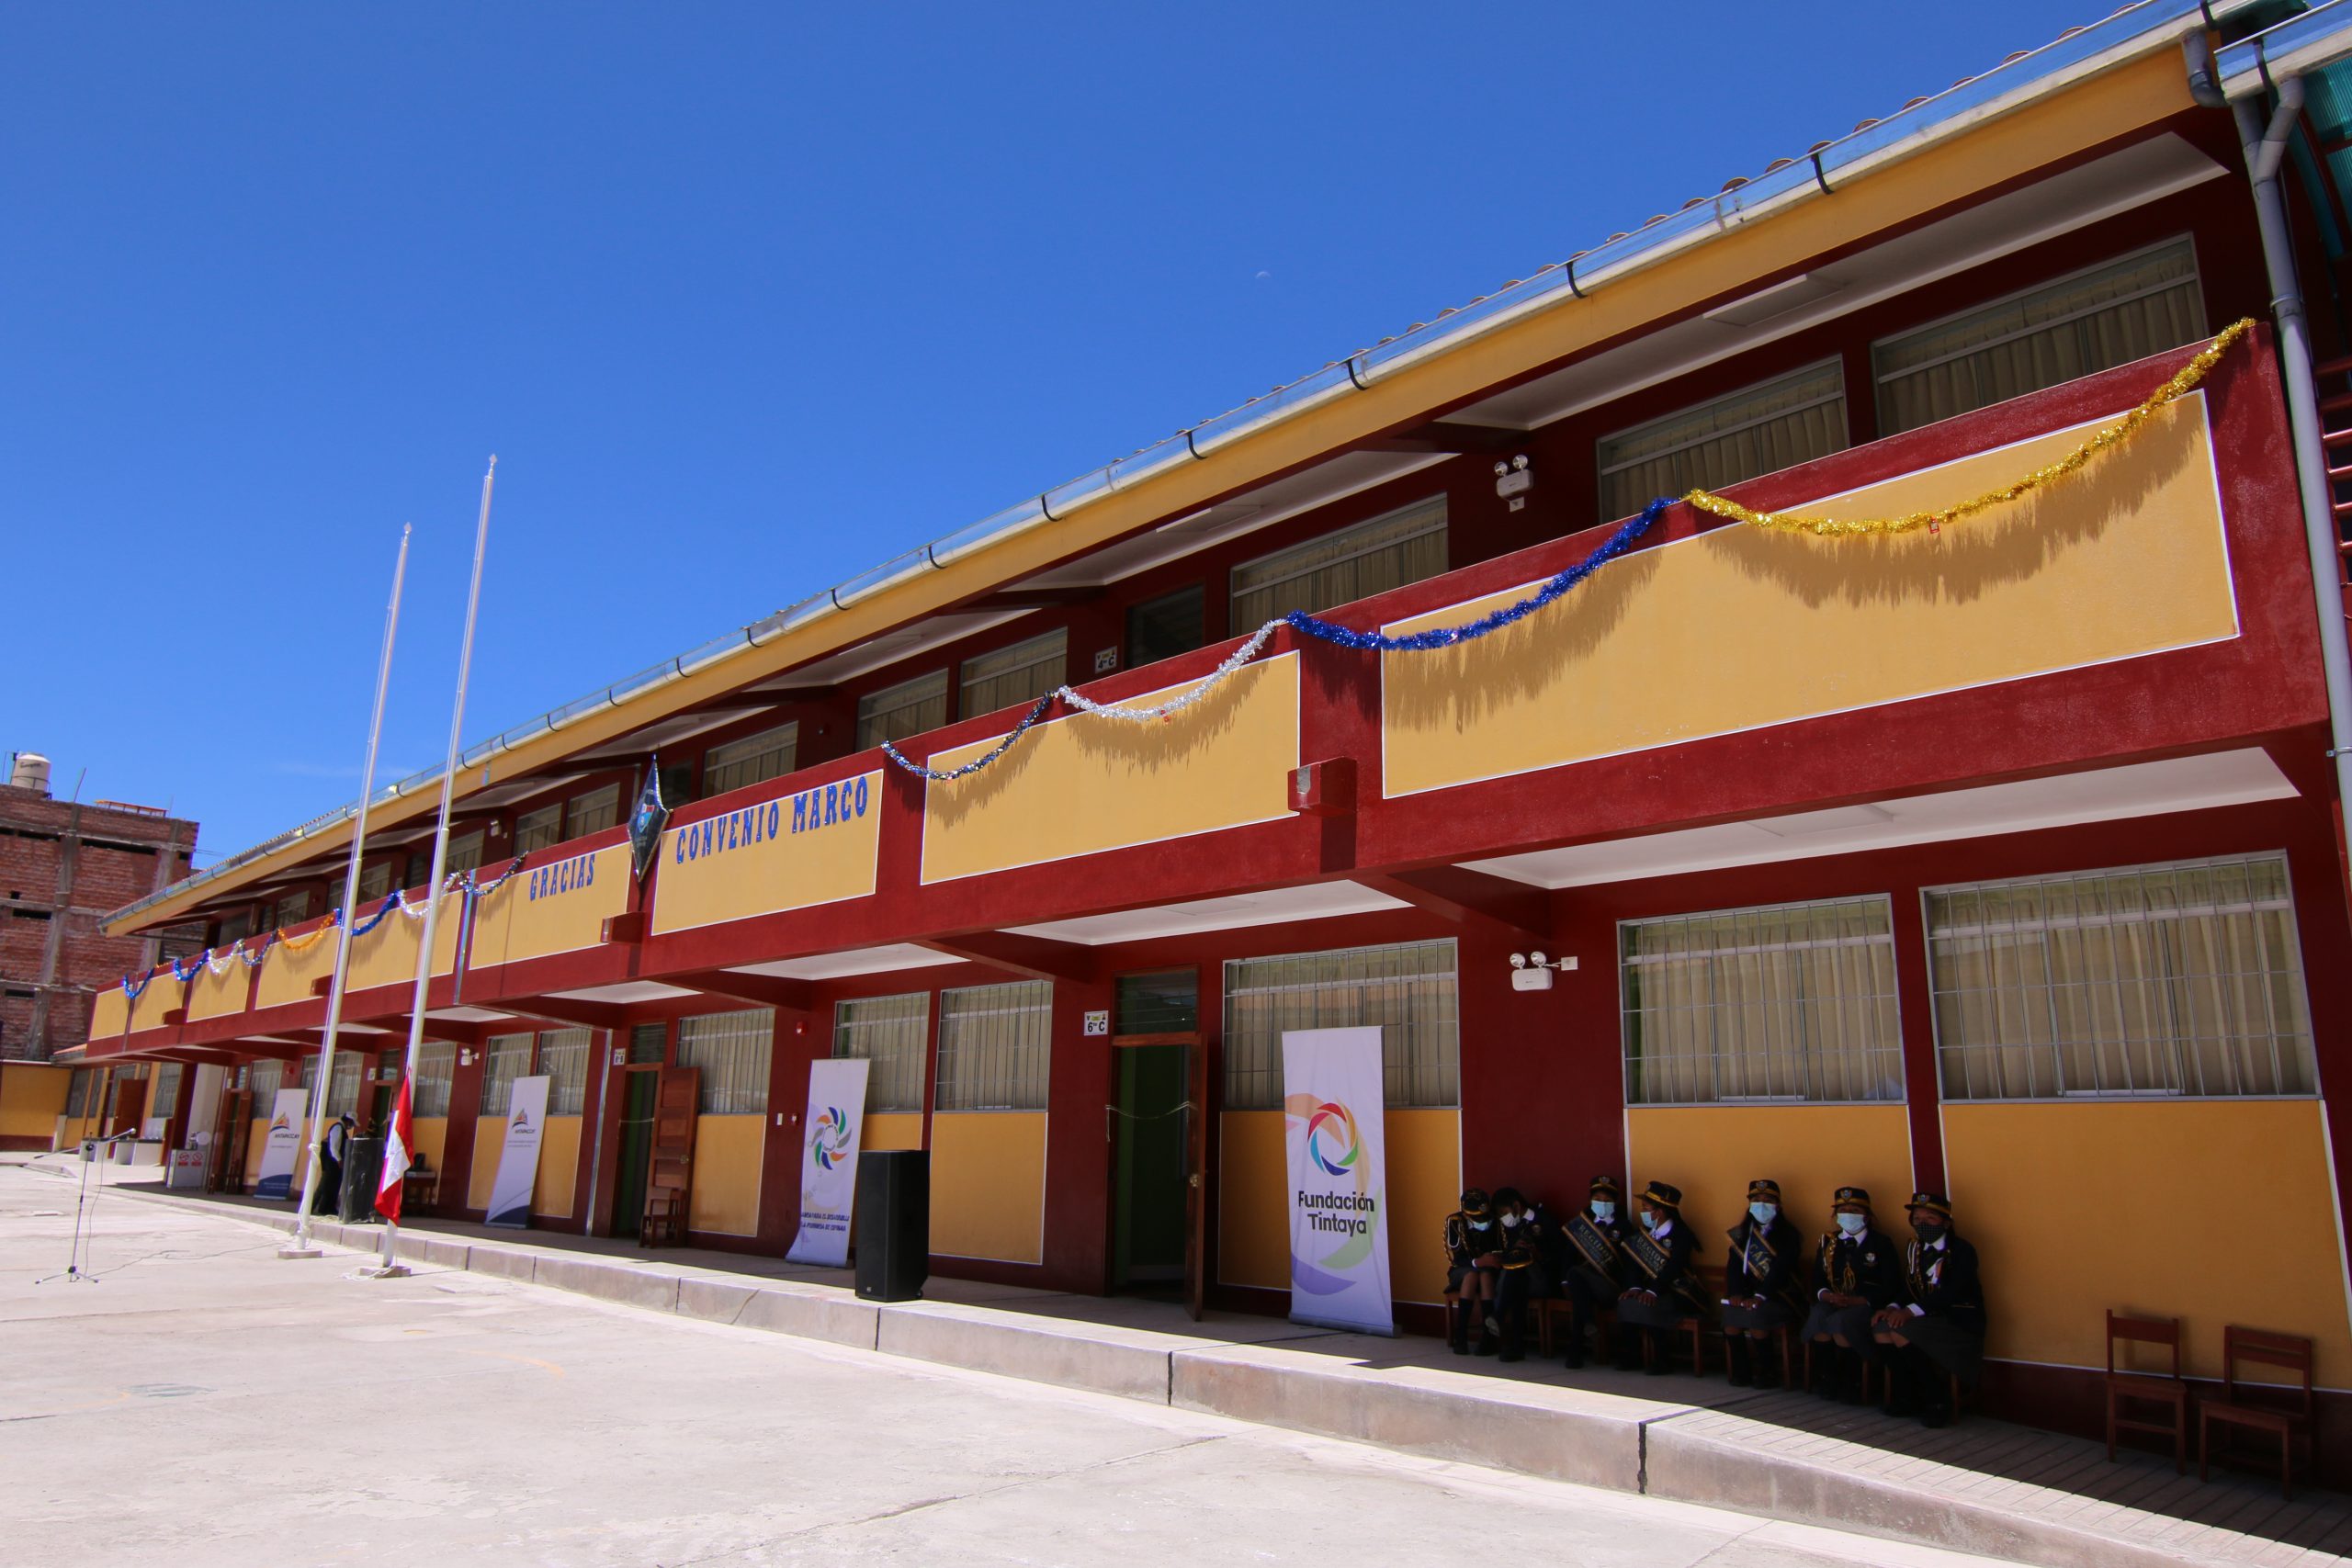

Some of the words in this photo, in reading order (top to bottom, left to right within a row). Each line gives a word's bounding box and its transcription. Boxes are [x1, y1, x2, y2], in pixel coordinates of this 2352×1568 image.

[676, 801, 779, 864] CONVENIO
[791, 776, 868, 834] MARCO
[529, 853, 595, 901] GRACIAS
[1098, 1021, 1105, 1032] C
[1298, 1190, 1374, 1212] Fundación
[1307, 1212, 1367, 1237] Tintaya
